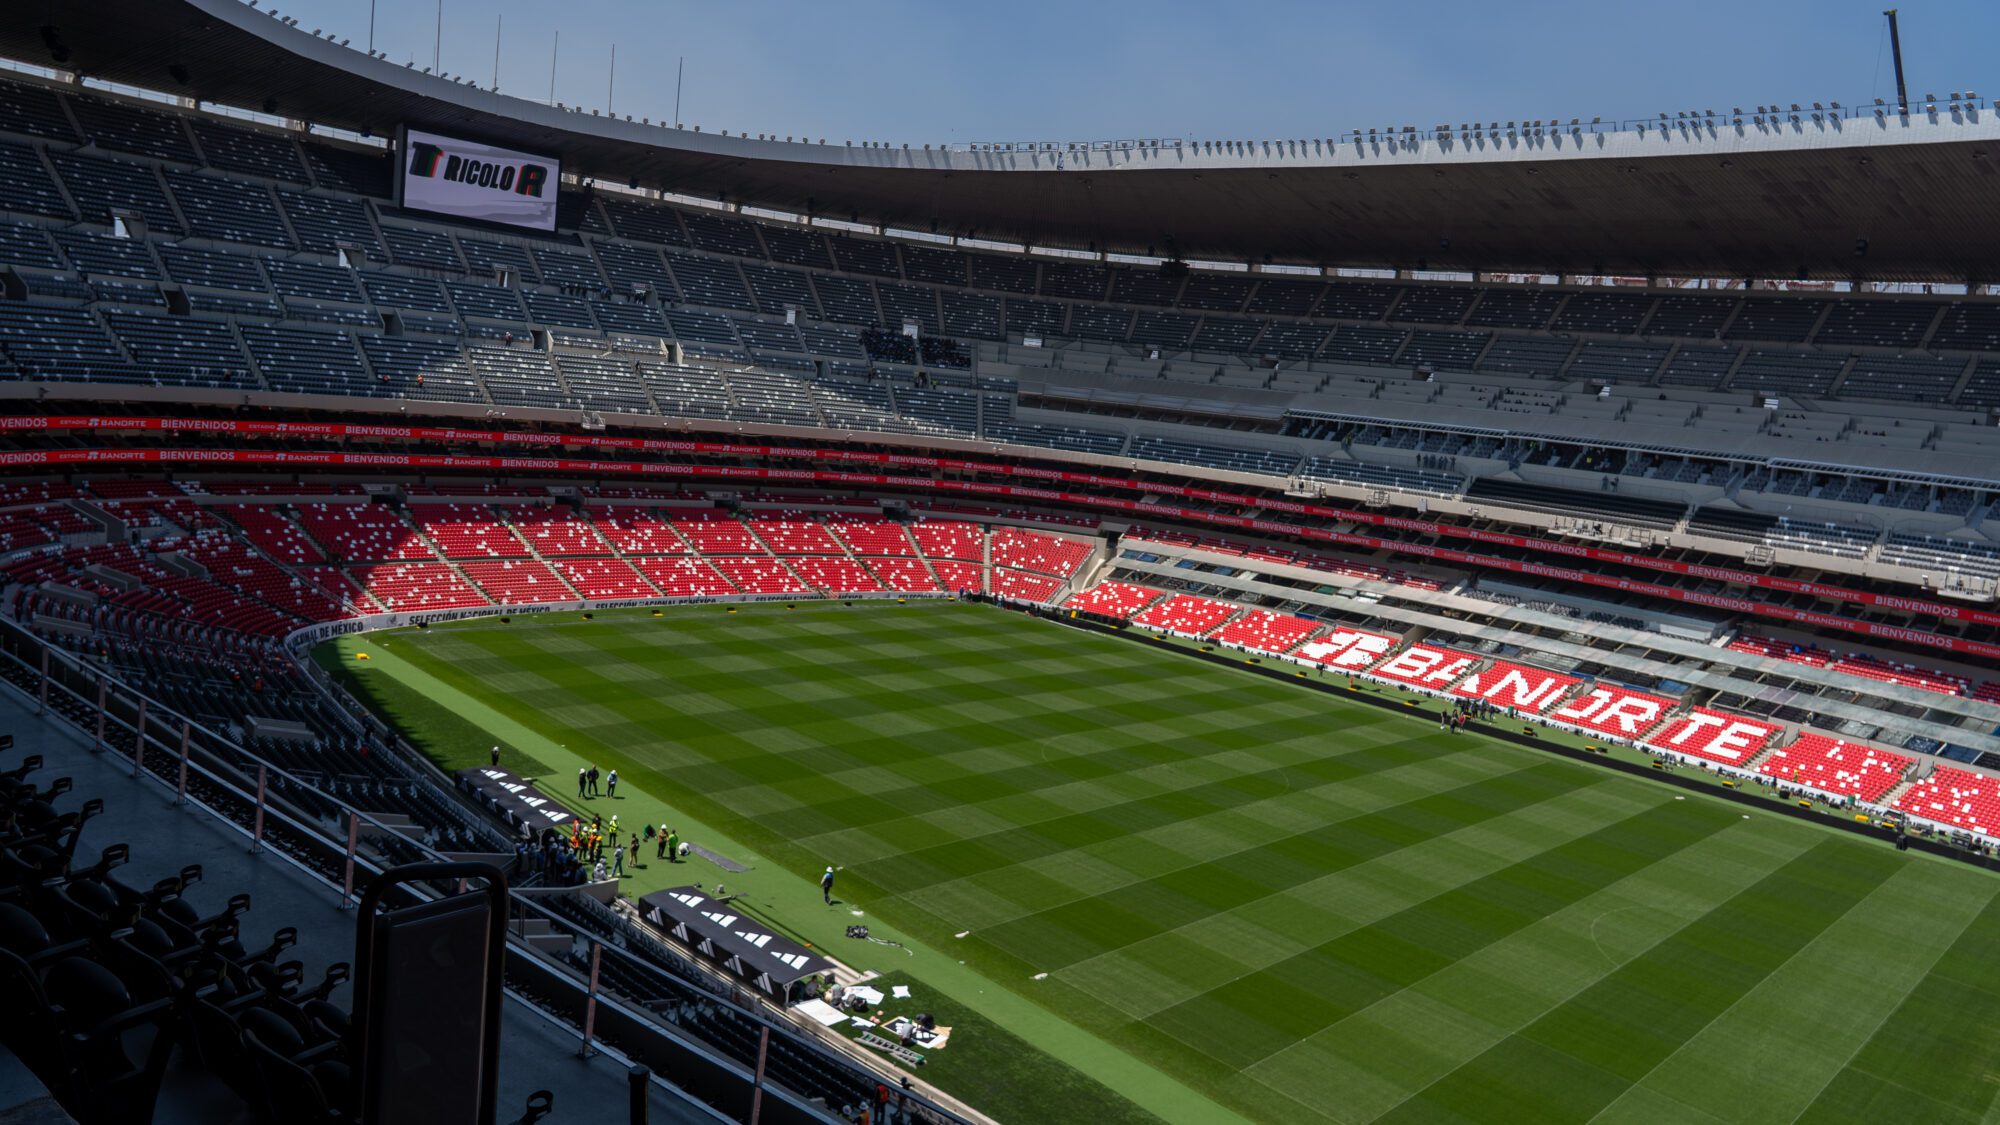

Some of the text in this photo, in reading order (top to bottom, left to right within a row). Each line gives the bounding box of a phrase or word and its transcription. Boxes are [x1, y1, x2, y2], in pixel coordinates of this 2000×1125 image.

[160, 451, 234, 460] BIENVENIDOS
[344, 455, 409, 464] BIENVENIDOS
[502, 460, 559, 468] BIENVENIDOS
[642, 465, 693, 473] BIENVENIDOS
[768, 470, 815, 479] BIENVENIDOS
[887, 477, 935, 486] BIENVENIDOS
[1011, 488, 1060, 499] BIENVENIDOS
[1135, 503, 1181, 515] BIENVENIDOS
[1253, 521, 1302, 535] BIENVENIDOS
[1381, 541, 1435, 556] BIENVENIDOS
[1476, 557, 1511, 568] BANORTE
[1522, 564, 1584, 581] BIENVENIDOS
[1630, 584, 1670, 596] BANORTE
[1684, 592, 1753, 611] BIENVENIDOS
[1808, 616, 1855, 629] BANORTE
[1870, 625, 1952, 647] BIENVENIDOS
[161, 420, 236, 429] BIENVENIDOS
[345, 426, 411, 436] BIENVENIDOS
[503, 433, 560, 443] BIENVENIDOS
[644, 440, 695, 450] BIENVENIDOS
[770, 448, 816, 457] BIENVENIDOS
[889, 456, 937, 465] BIENVENIDOS
[1013, 467, 1062, 478] BIENVENIDOS
[1138, 482, 1184, 494] BIENVENIDOS
[1256, 499, 1304, 513] BIENVENIDOS
[1385, 517, 1438, 532] BIENVENIDOS
[1479, 534, 1514, 544] BANORTE
[1526, 540, 1587, 556] BIENVENIDOS
[1634, 558, 1674, 569] BANORTE
[1688, 566, 1758, 584] BIENVENIDOS
[1813, 588, 1860, 600] BANORTE
[1875, 596, 1959, 617] BIENVENIDOS
[319, 626, 330, 639] DE
[331, 621, 364, 638] MÉXICO
